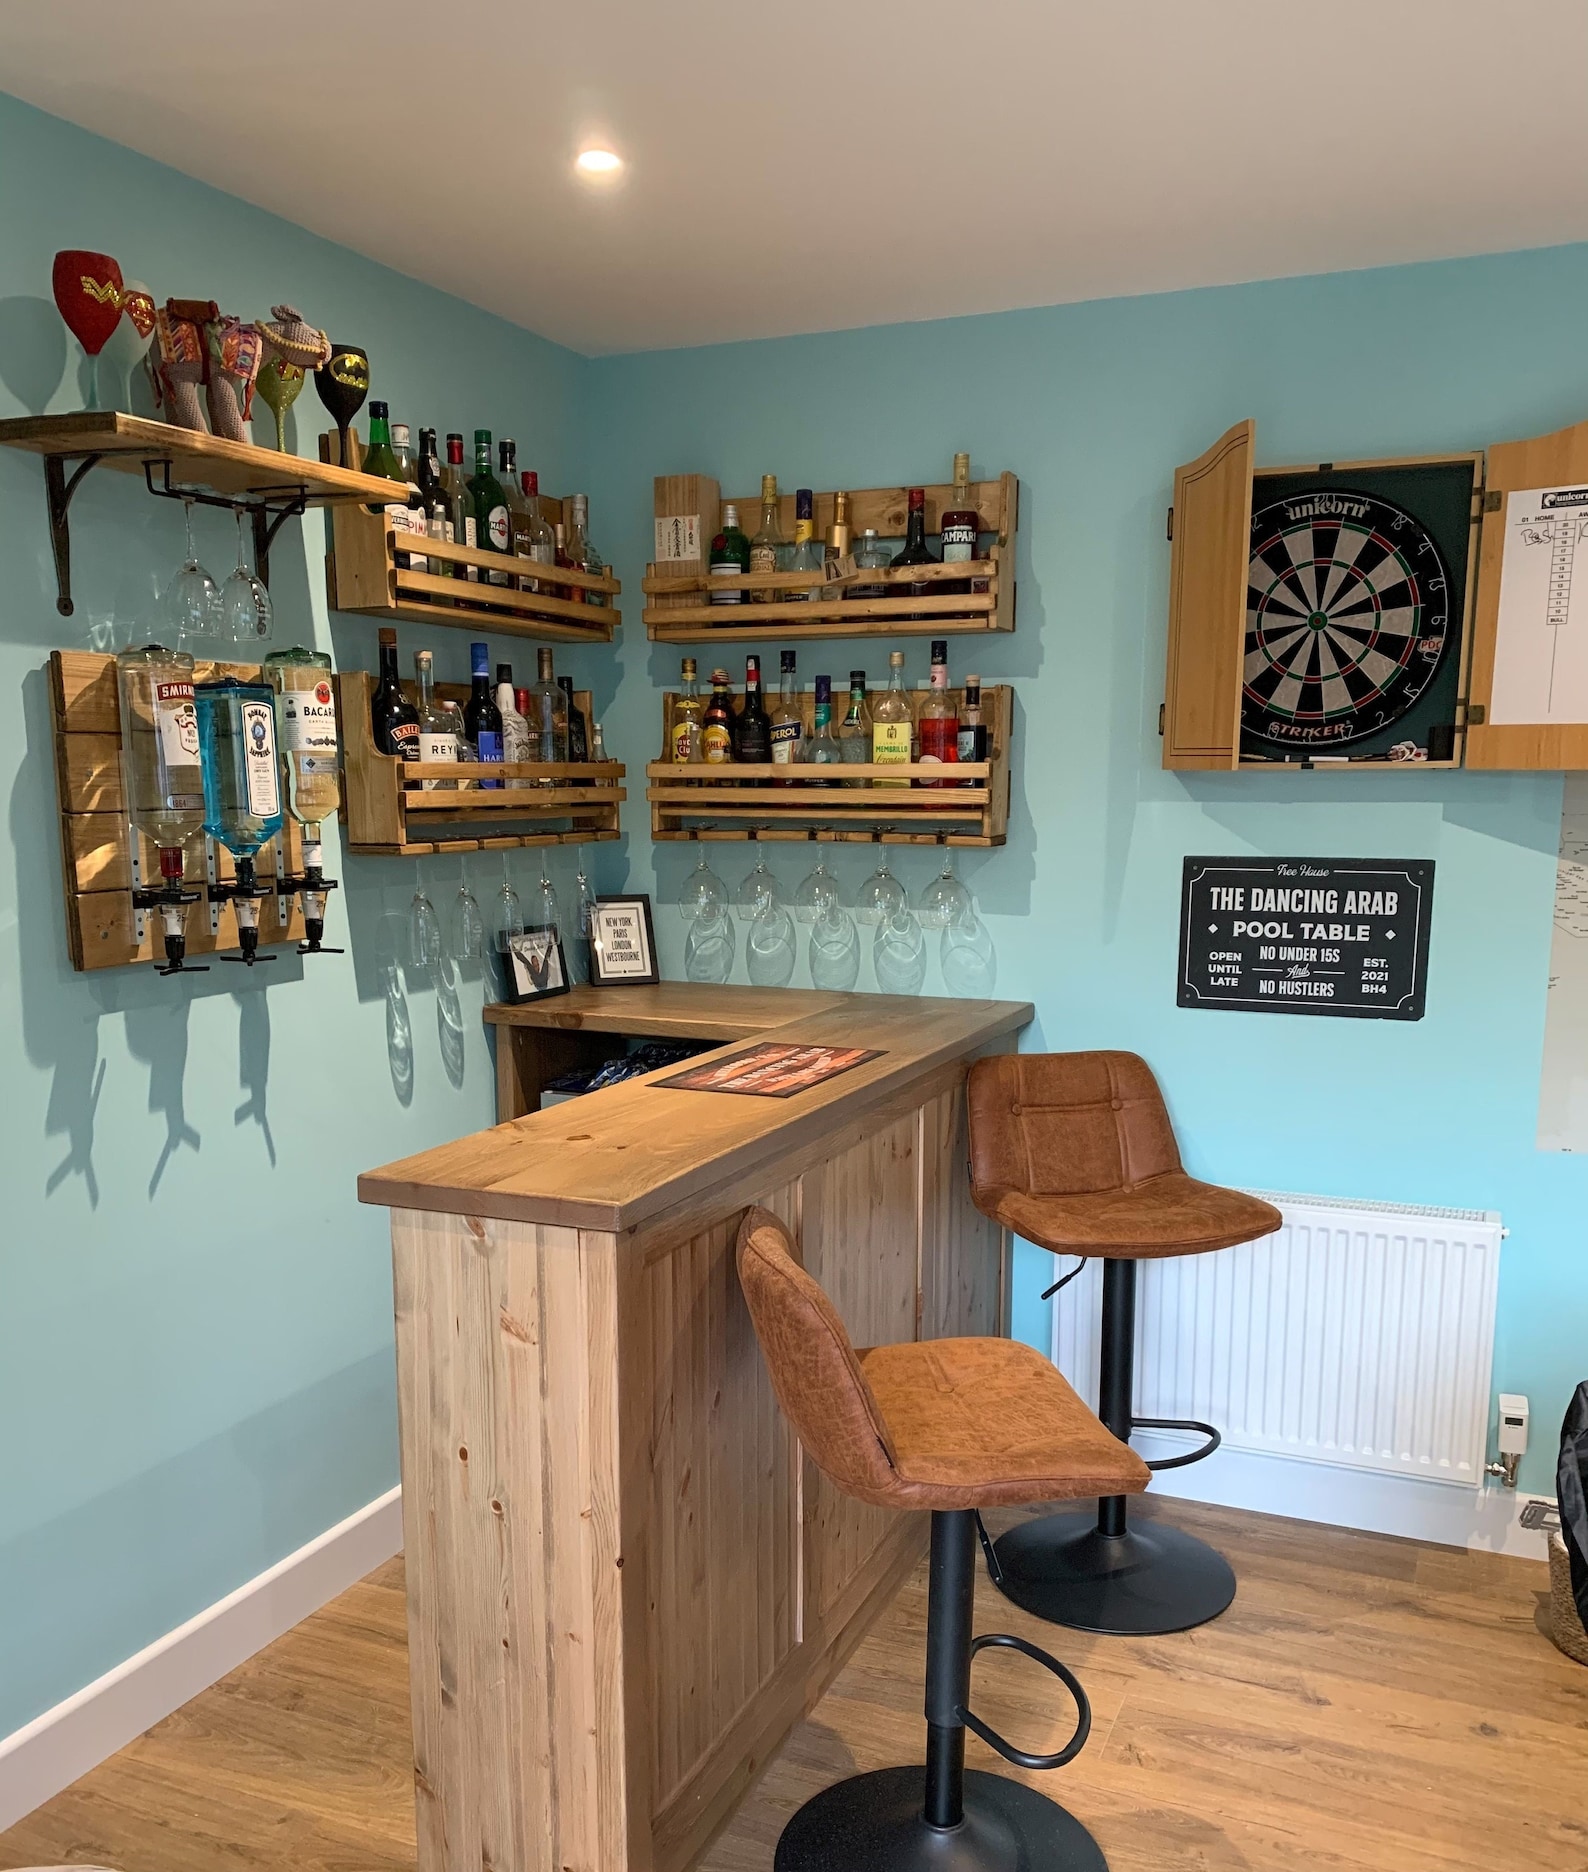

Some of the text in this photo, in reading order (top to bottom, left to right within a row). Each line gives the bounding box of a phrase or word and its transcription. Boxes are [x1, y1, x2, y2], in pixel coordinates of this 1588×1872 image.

[1288, 501, 1366, 521] unicorn
[1535, 514, 1554, 522] HOME
[1277, 864, 1330, 877] Tree House
[1210, 887, 1398, 916] THE DANCING ARAB
[605, 916, 632, 927] NEW YORK
[612, 928, 628, 938] PARIS
[1233, 921, 1371, 942] POOL TABLE
[611, 940, 632, 950] LONDON
[605, 951, 640, 962] WESTBOURNE
[1209, 951, 1242, 962] OPEN
[1260, 945, 1341, 963] NO UNDER 15S
[1363, 957, 1389, 968] EST.
[1208, 964, 1243, 975] UNTIL
[1285, 963, 1311, 980] And
[1210, 976, 1239, 987] LATE
[1361, 971, 1389, 982] 2021
[1259, 980, 1335, 998] NO HUSTLERS
[1361, 983, 1387, 994] BH4
